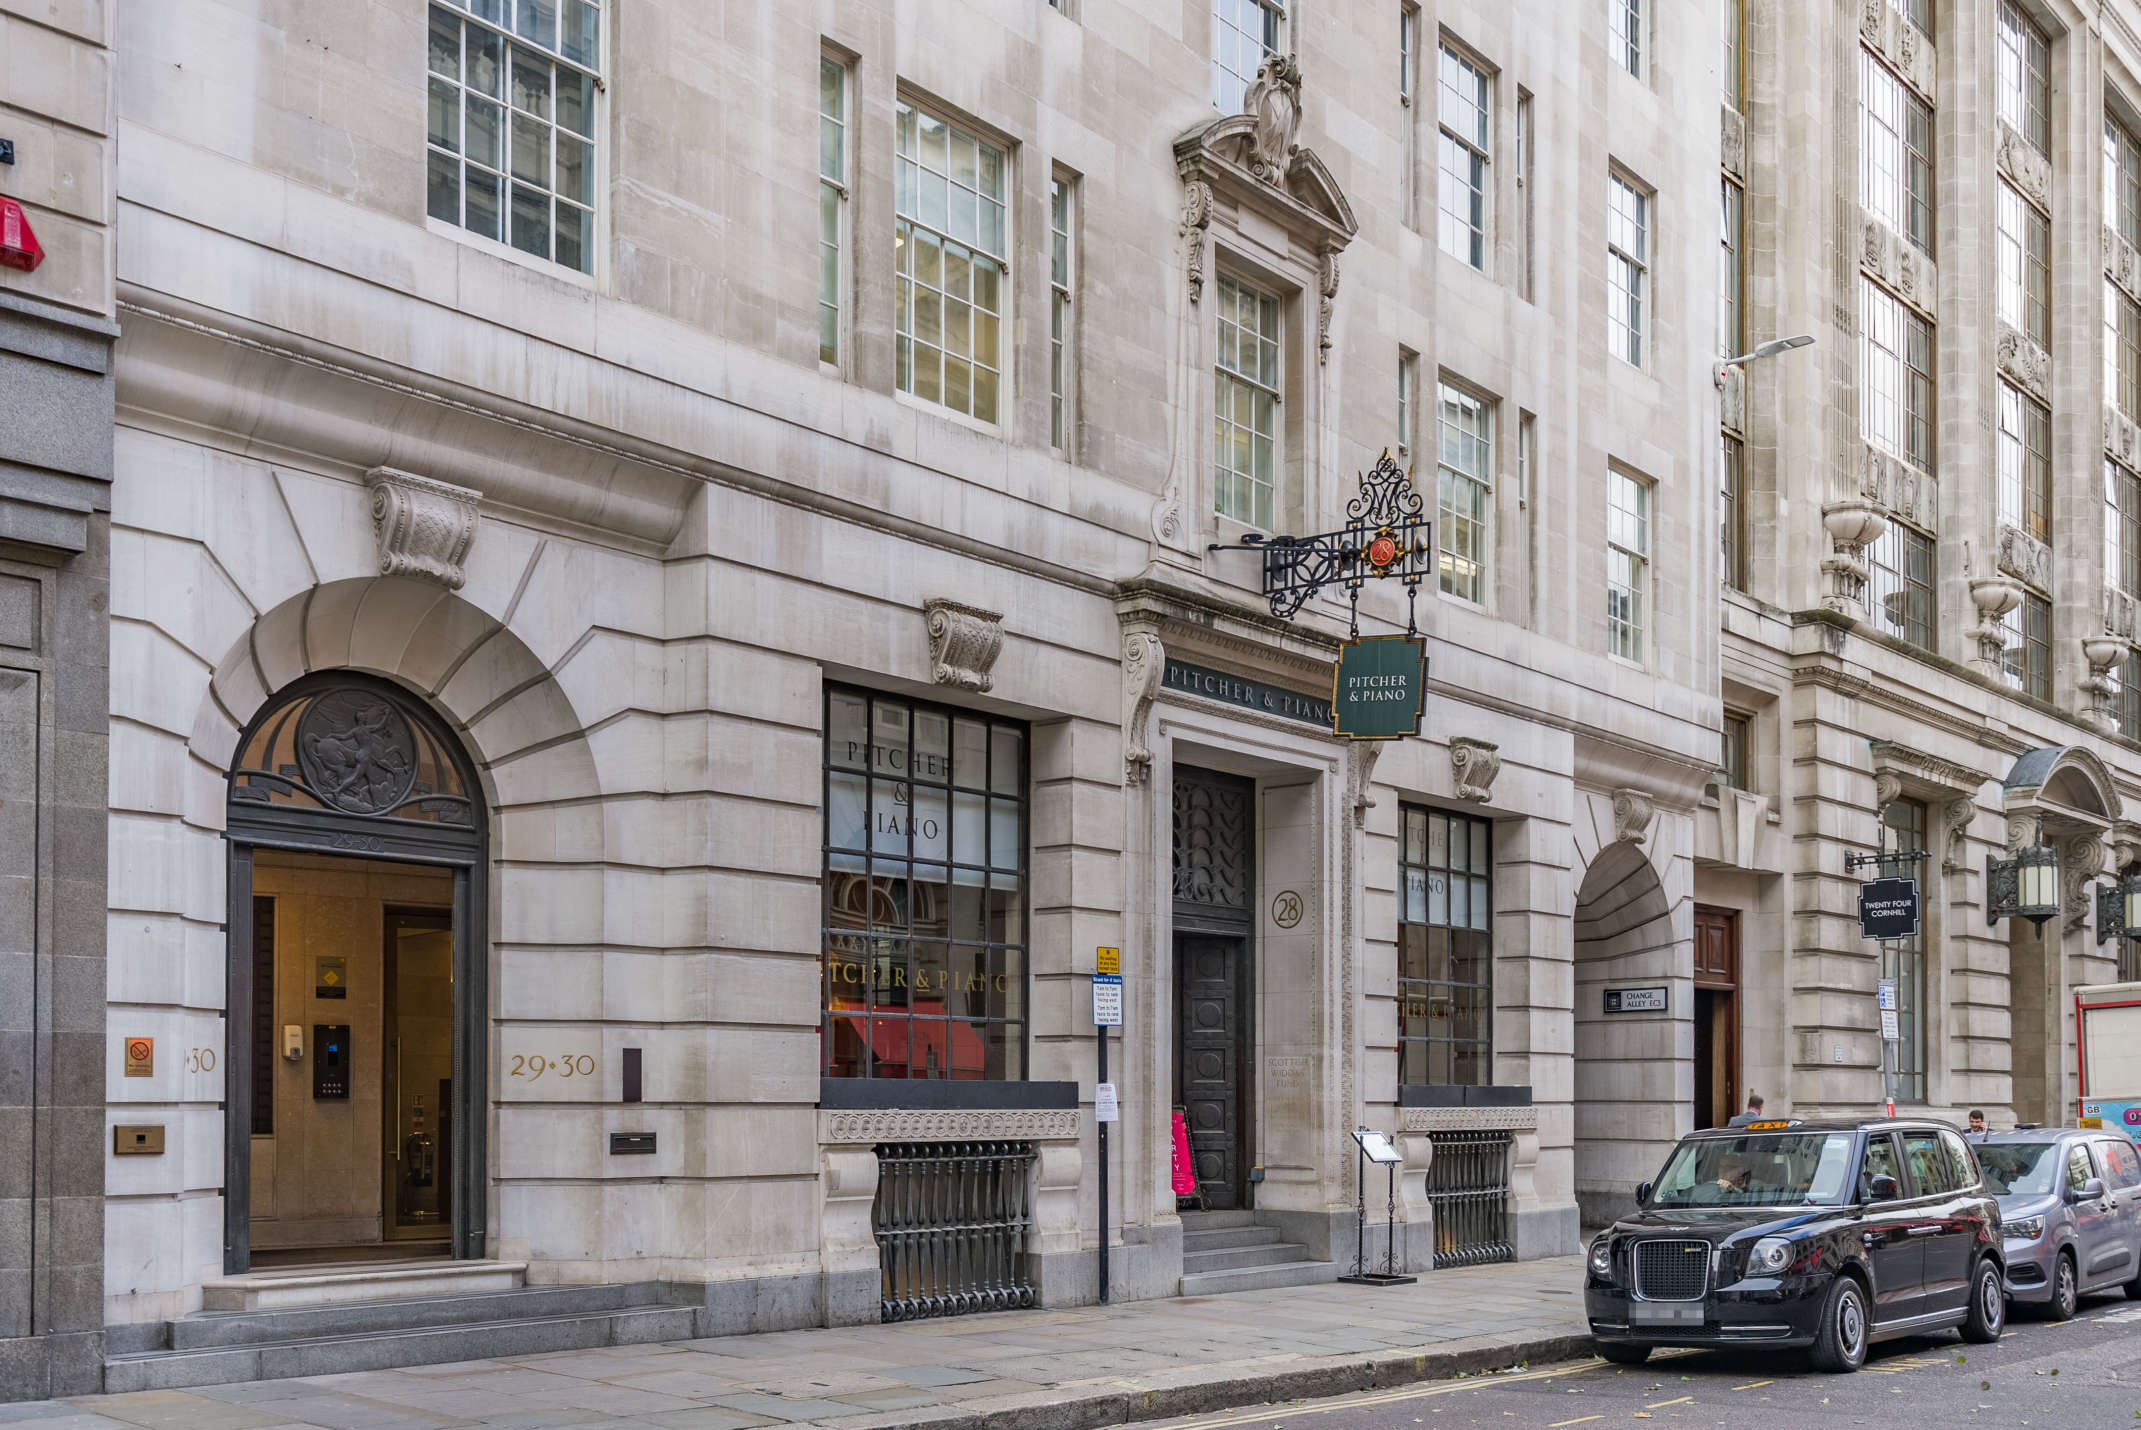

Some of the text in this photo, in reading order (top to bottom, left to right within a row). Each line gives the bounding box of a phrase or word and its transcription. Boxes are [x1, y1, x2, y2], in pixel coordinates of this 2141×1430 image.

[1373, 542, 1390, 561] 28
[1170, 666, 1254, 703] PITCHER
[1263, 690, 1274, 708] &
[1349, 674, 1407, 688] PITCHER
[1349, 689, 1406, 702] & PIANO
[893, 781, 908, 807] &
[1277, 897, 1299, 922] 28
[1864, 899, 1912, 910] TWENTY FOUR
[1871, 909, 1906, 918] CORNHILL
[916, 968, 930, 992] &
[938, 970, 1009, 993] PIANO
[1626, 992, 1656, 1000] CHANGE
[1626, 1000, 1646, 1008] ALLEY
[2087, 1106, 2100, 1114] GB
[1751, 1121, 1787, 1129] TAXI
